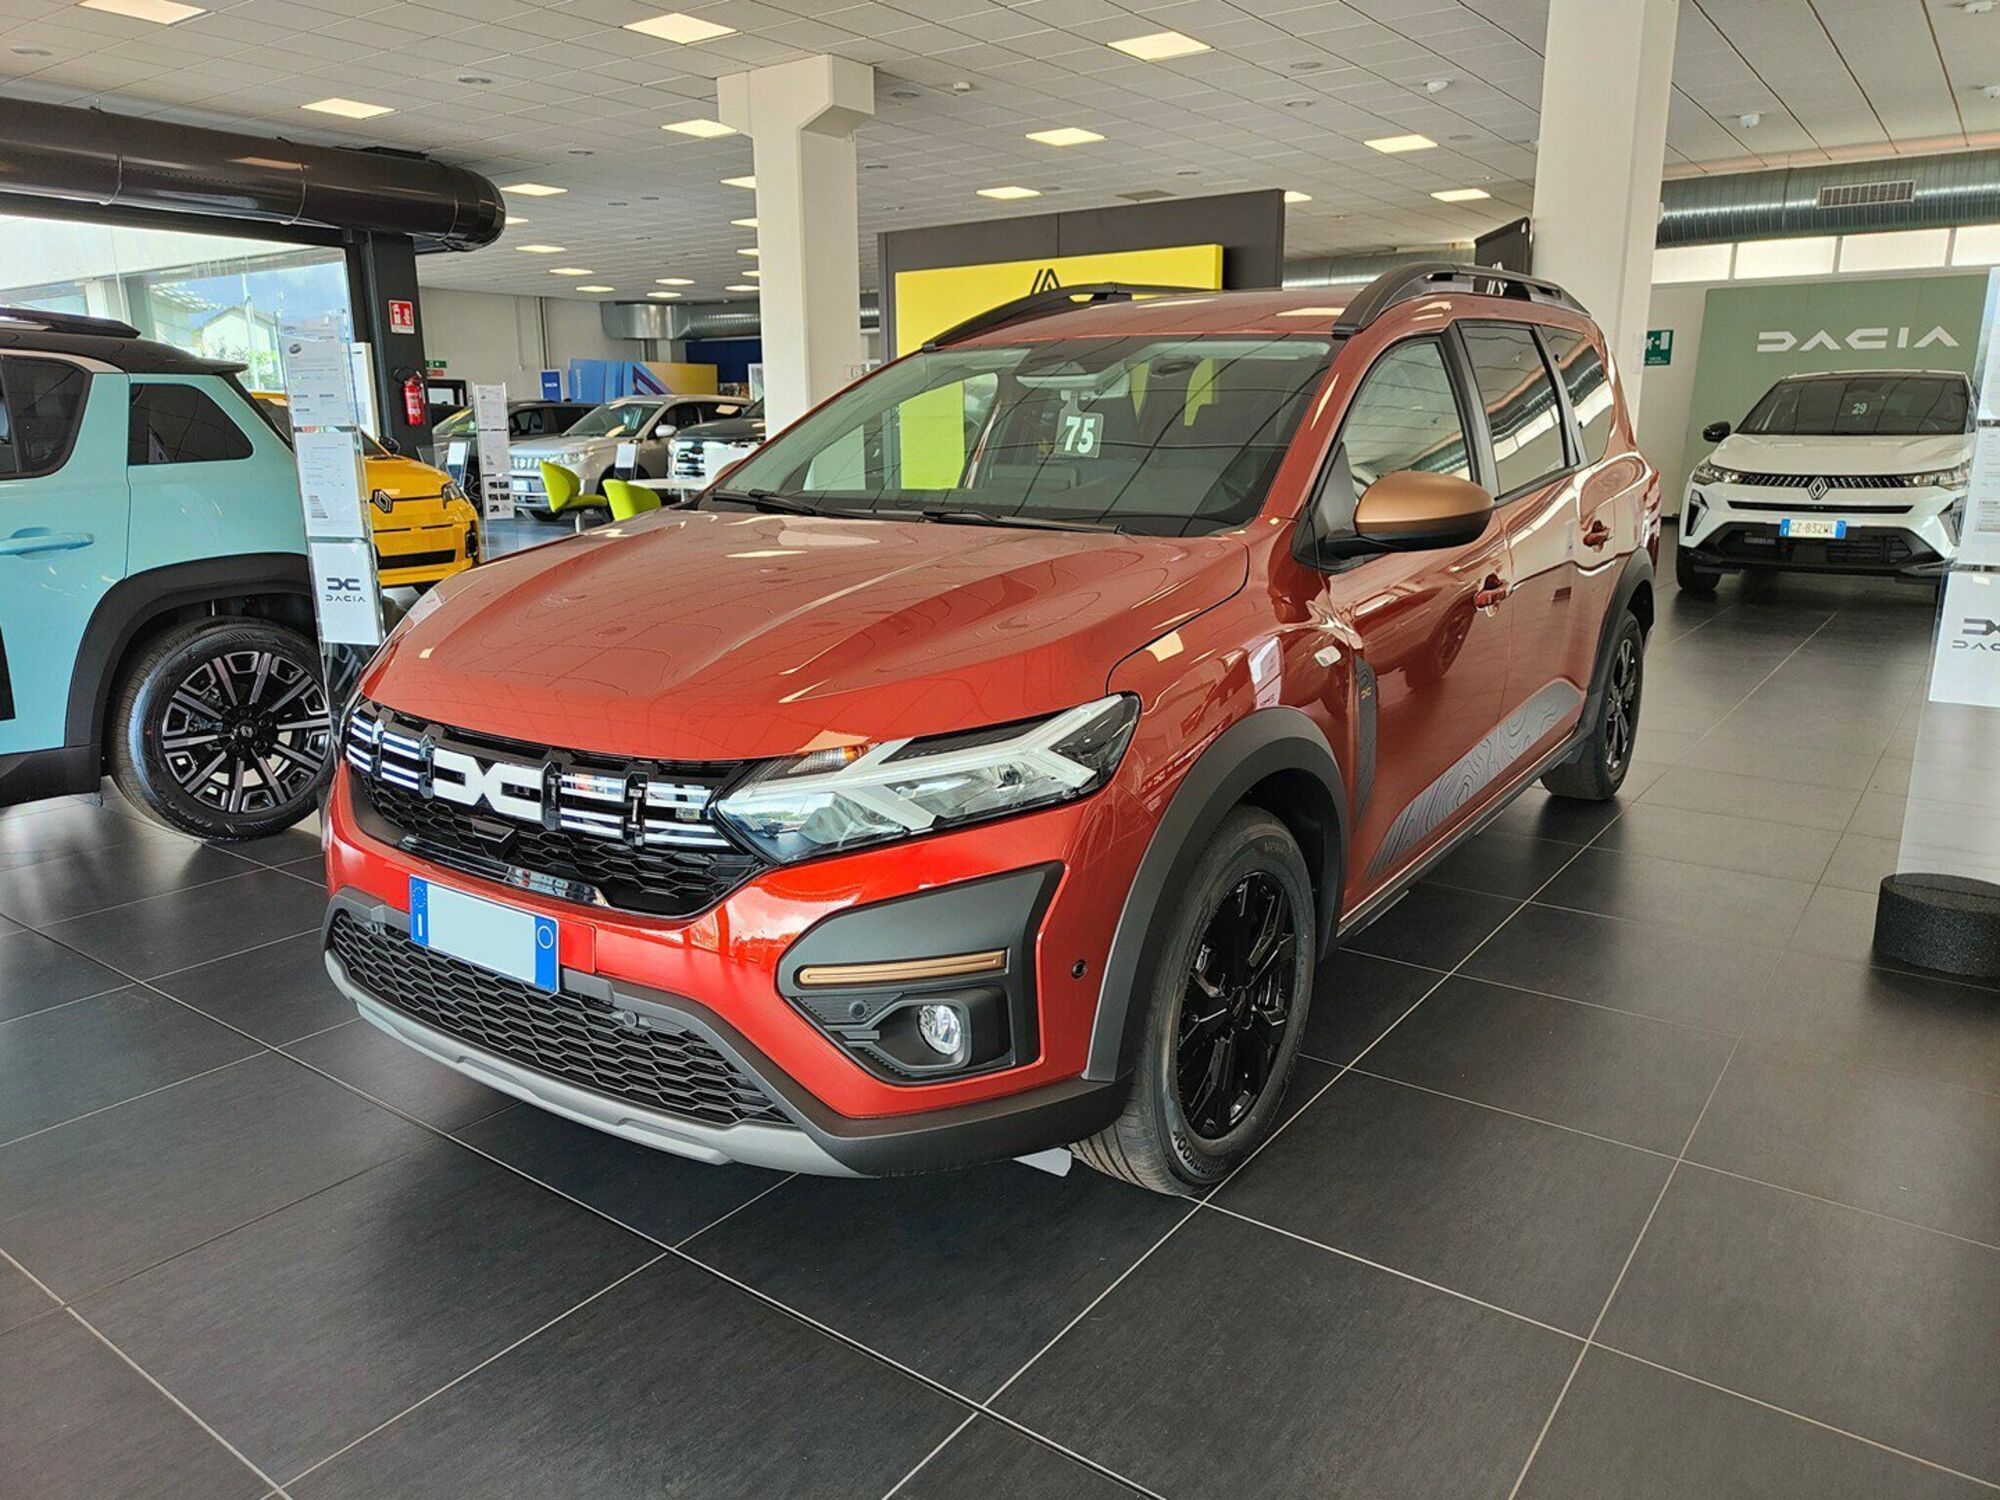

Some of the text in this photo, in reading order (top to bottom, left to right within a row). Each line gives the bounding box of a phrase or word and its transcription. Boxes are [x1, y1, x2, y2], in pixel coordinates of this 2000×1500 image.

[1757, 326, 1960, 352] DACIA
[1852, 403, 1867, 415] 29
[1064, 416, 1095, 454] 75
[325, 594, 366, 602] DACIA
